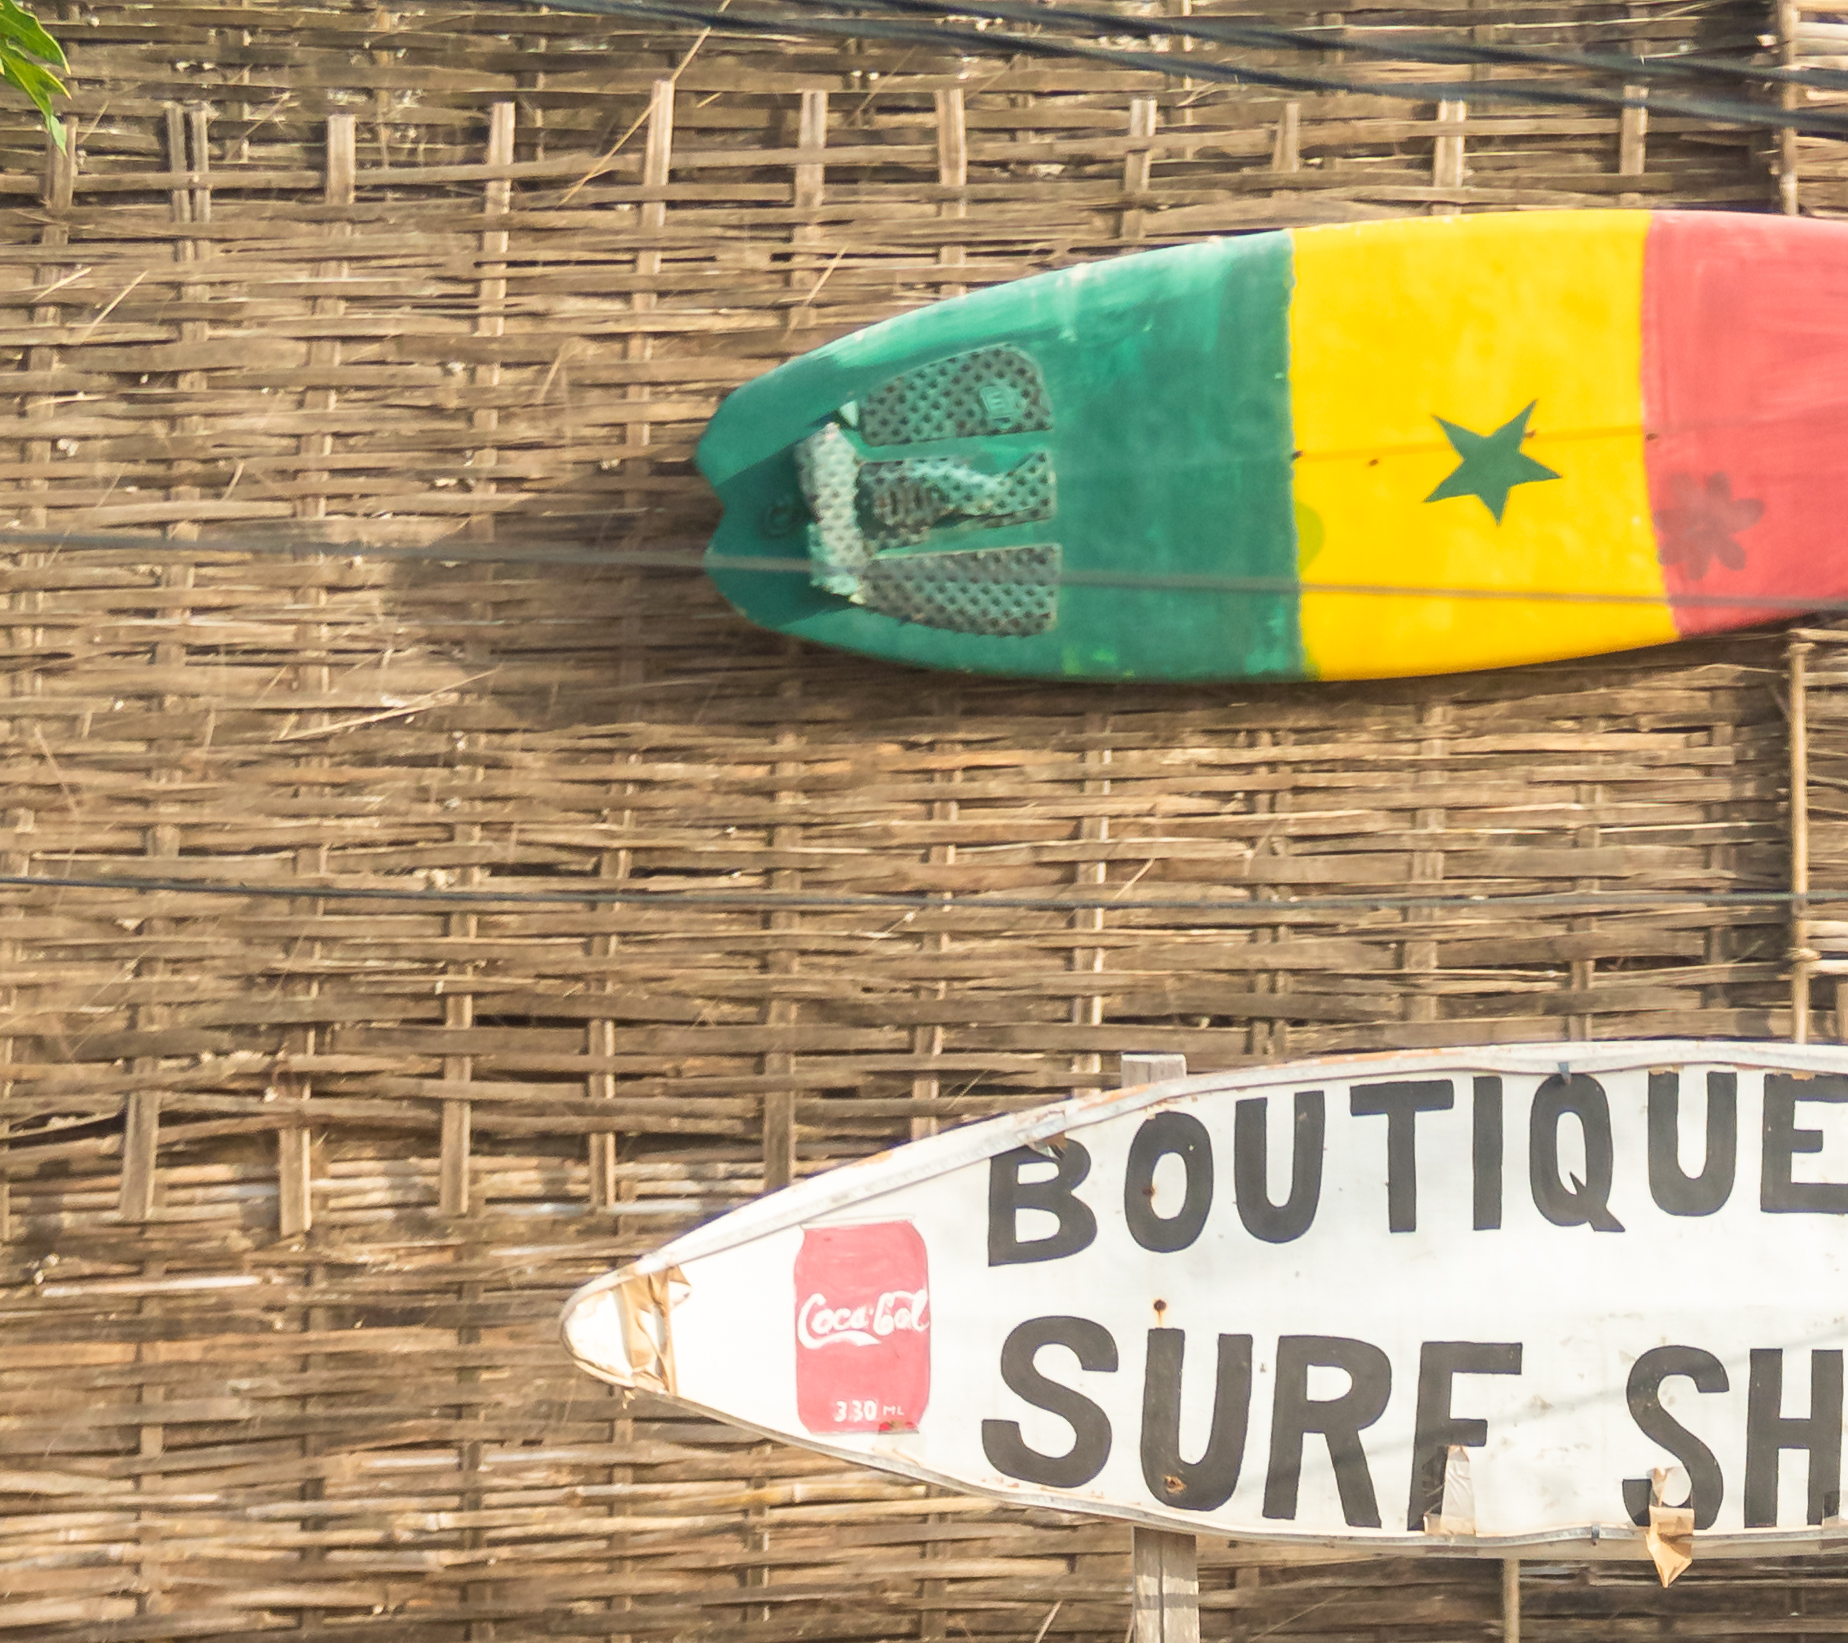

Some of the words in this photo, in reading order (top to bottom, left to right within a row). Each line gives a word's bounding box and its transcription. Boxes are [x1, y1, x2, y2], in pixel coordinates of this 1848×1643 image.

[834, 1400, 878, 1422] 330
[883, 1406, 905, 1416] ML
[981, 1316, 1523, 1532] SURF
